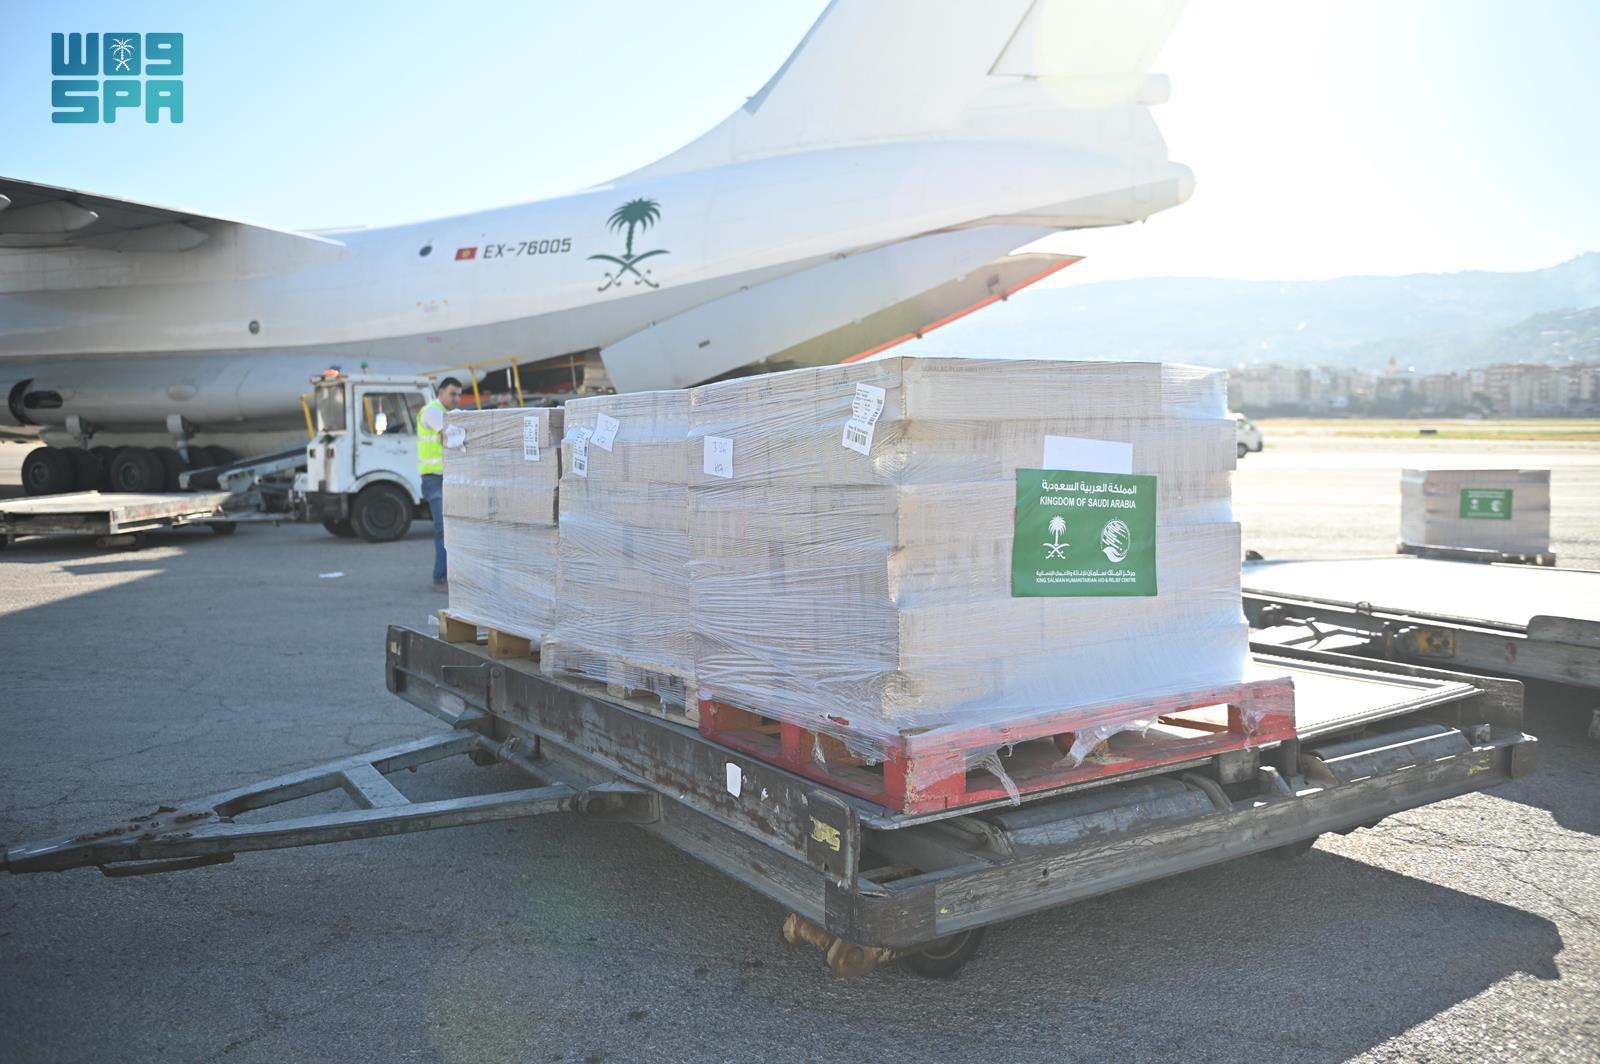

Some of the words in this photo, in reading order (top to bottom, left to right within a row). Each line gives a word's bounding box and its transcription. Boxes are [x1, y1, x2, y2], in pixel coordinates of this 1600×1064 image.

[483, 238, 572, 259] EX-76005
[1041, 479, 1079, 492] السعودية
[1080, 480, 1107, 494] العربية
[1108, 482, 1137, 495] المملكة
[1040, 496, 1075, 506] KINGDOM
[1076, 497, 1087, 507] OF
[1088, 498, 1109, 508] SAUDI
[1110, 499, 1136, 509] ARABIA
